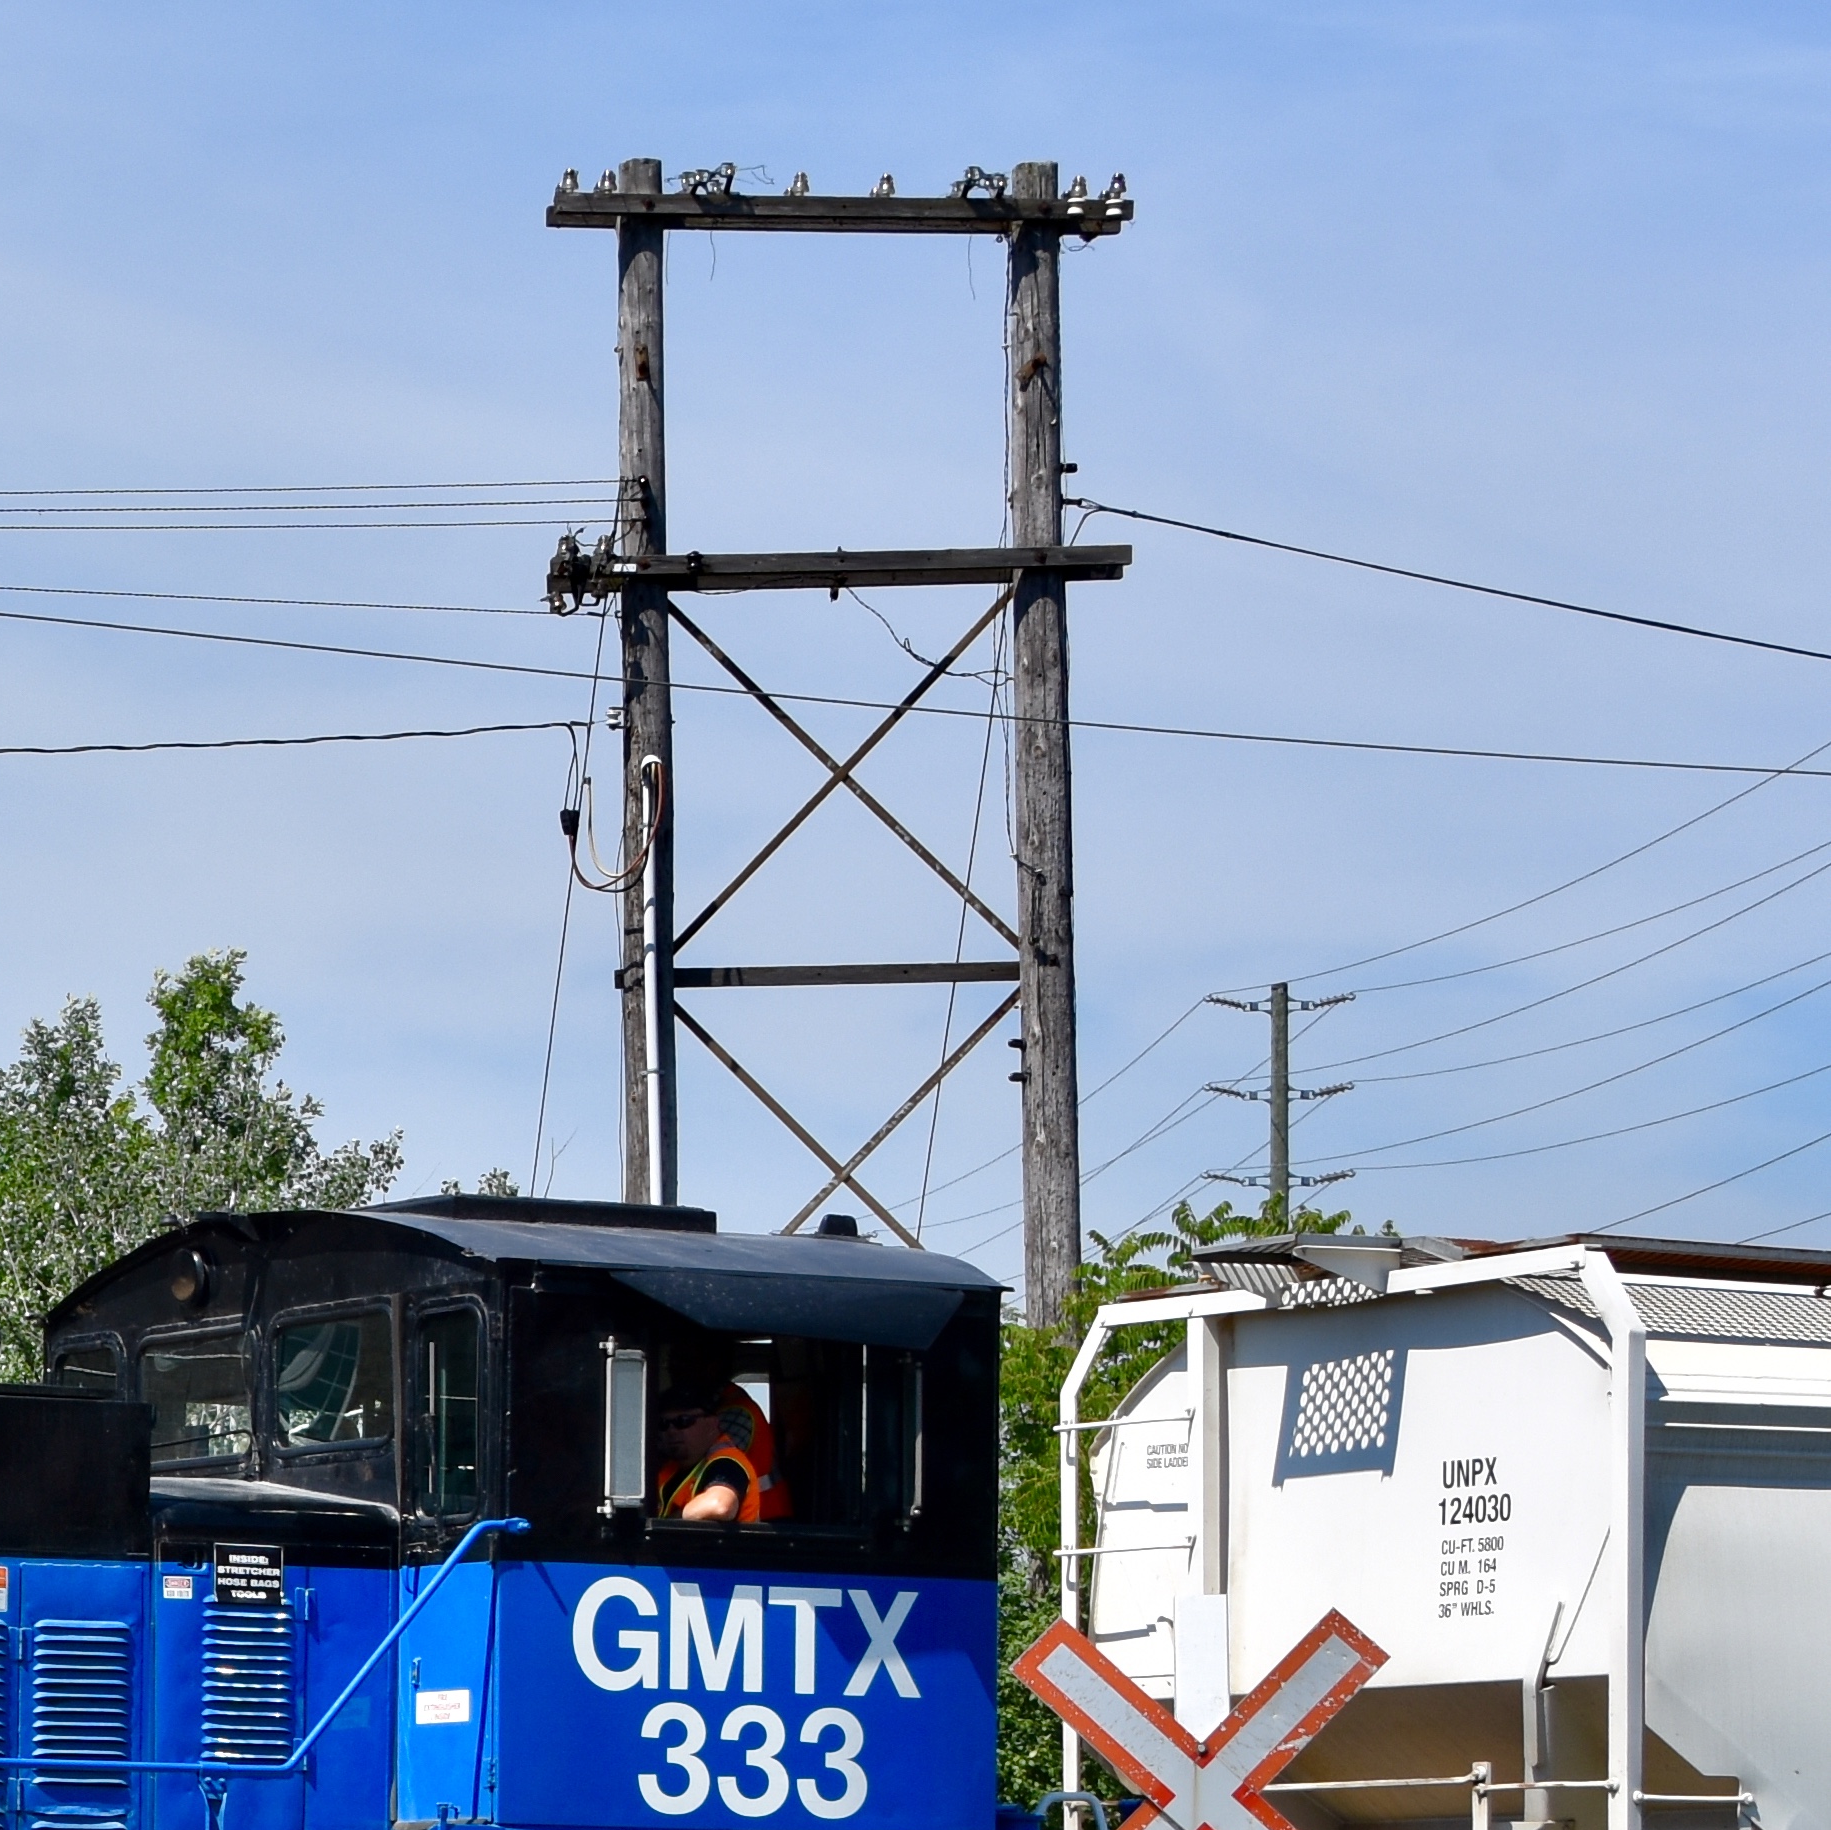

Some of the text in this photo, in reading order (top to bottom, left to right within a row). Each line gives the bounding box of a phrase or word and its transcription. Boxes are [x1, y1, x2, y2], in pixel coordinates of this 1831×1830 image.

[1147, 1444, 1176, 1455] CAUTION
[1443, 1457, 1497, 1489] UNPX
[1439, 1493, 1511, 1525] 124030
[1442, 1536, 1504, 1555] CU-FT. 5800
[217, 1565, 280, 1577] STRETCHER
[1441, 1561, 1455, 1576] CU
[1478, 1558, 1496, 1573] 164
[217, 1577, 280, 1589] HOSE BAGS
[1440, 1579, 1496, 1597] SPRG D-5
[230, 1590, 267, 1599] TOOLS
[572, 1576, 921, 1698] GMTX
[638, 1702, 868, 1819] 333
